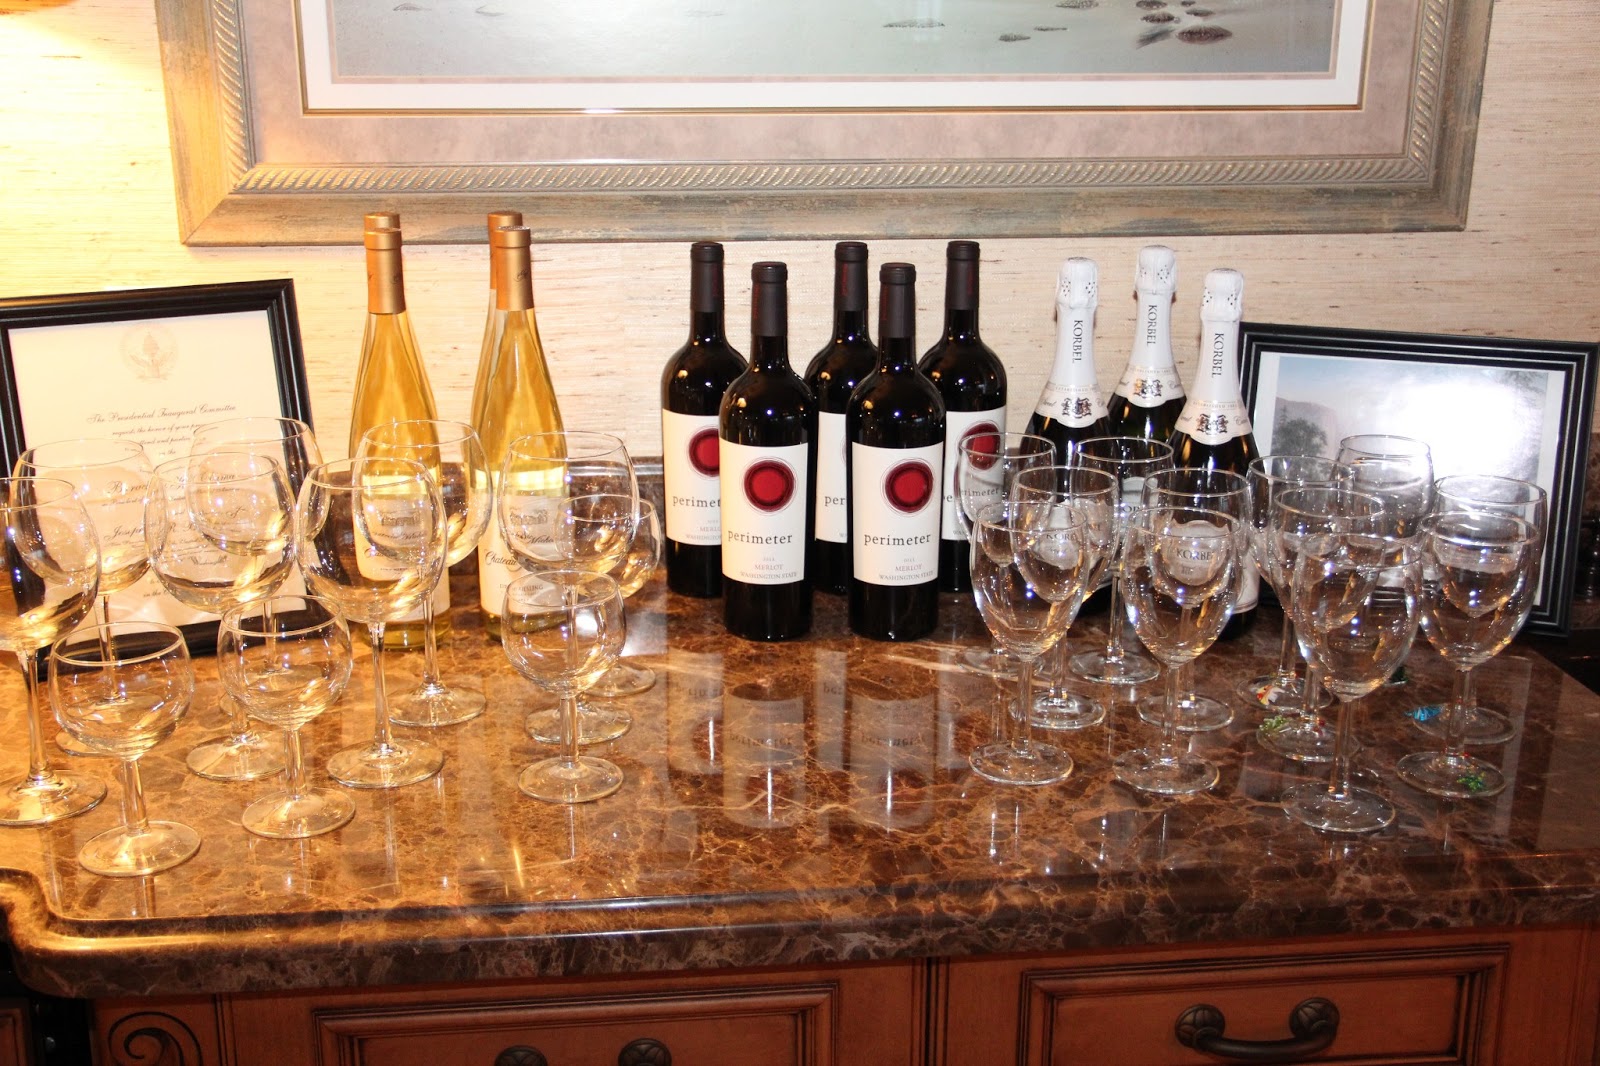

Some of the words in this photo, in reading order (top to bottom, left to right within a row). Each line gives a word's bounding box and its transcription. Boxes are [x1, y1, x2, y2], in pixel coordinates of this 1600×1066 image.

[1146, 304, 1158, 347] KORBEL
[1072, 320, 1083, 364] KORBEL
[1211, 333, 1225, 378] KORBEL
[86, 413, 105, 424] The
[108, 411, 154, 423] Presidential
[157, 407, 197, 419] Inaugural
[199, 403, 236, 414] Committee
[672, 496, 721, 508] perimet
[728, 530, 793, 545] perimeter
[864, 534, 931, 546] perimeter
[485, 550, 519, 567] Chateau
[740, 571, 781, 579] WASHINGTON
[895, 563, 923, 572] MERLOT
[879, 573, 920, 581] WASHINGTON
